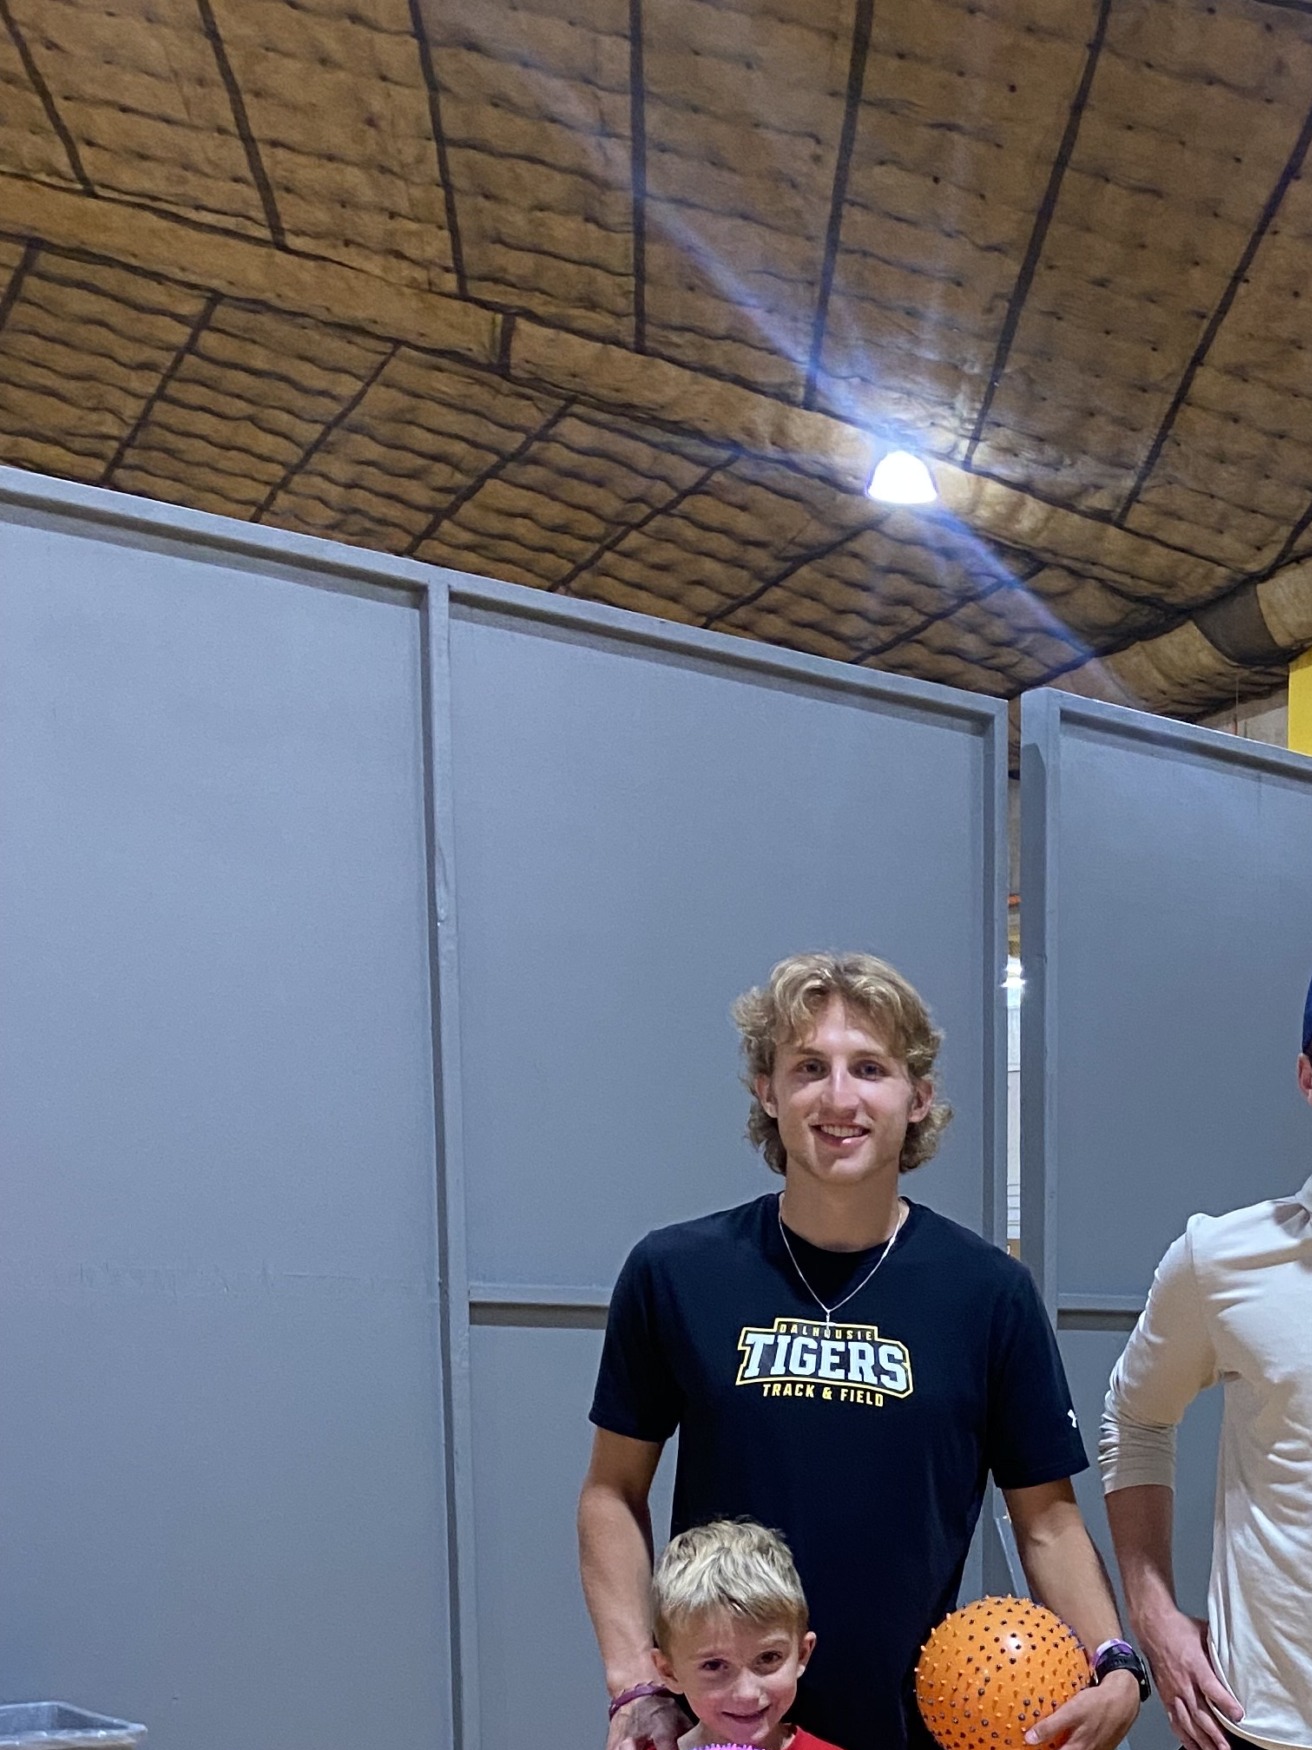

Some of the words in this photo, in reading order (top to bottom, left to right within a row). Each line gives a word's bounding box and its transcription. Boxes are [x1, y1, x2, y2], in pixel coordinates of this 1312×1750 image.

[779, 1323, 873, 1341] DALHOUSIE
[743, 1332, 908, 1392] TIGERS
[763, 1383, 815, 1398] TRACK
[821, 1386, 833, 1400] &
[840, 1388, 884, 1407] FIELD
